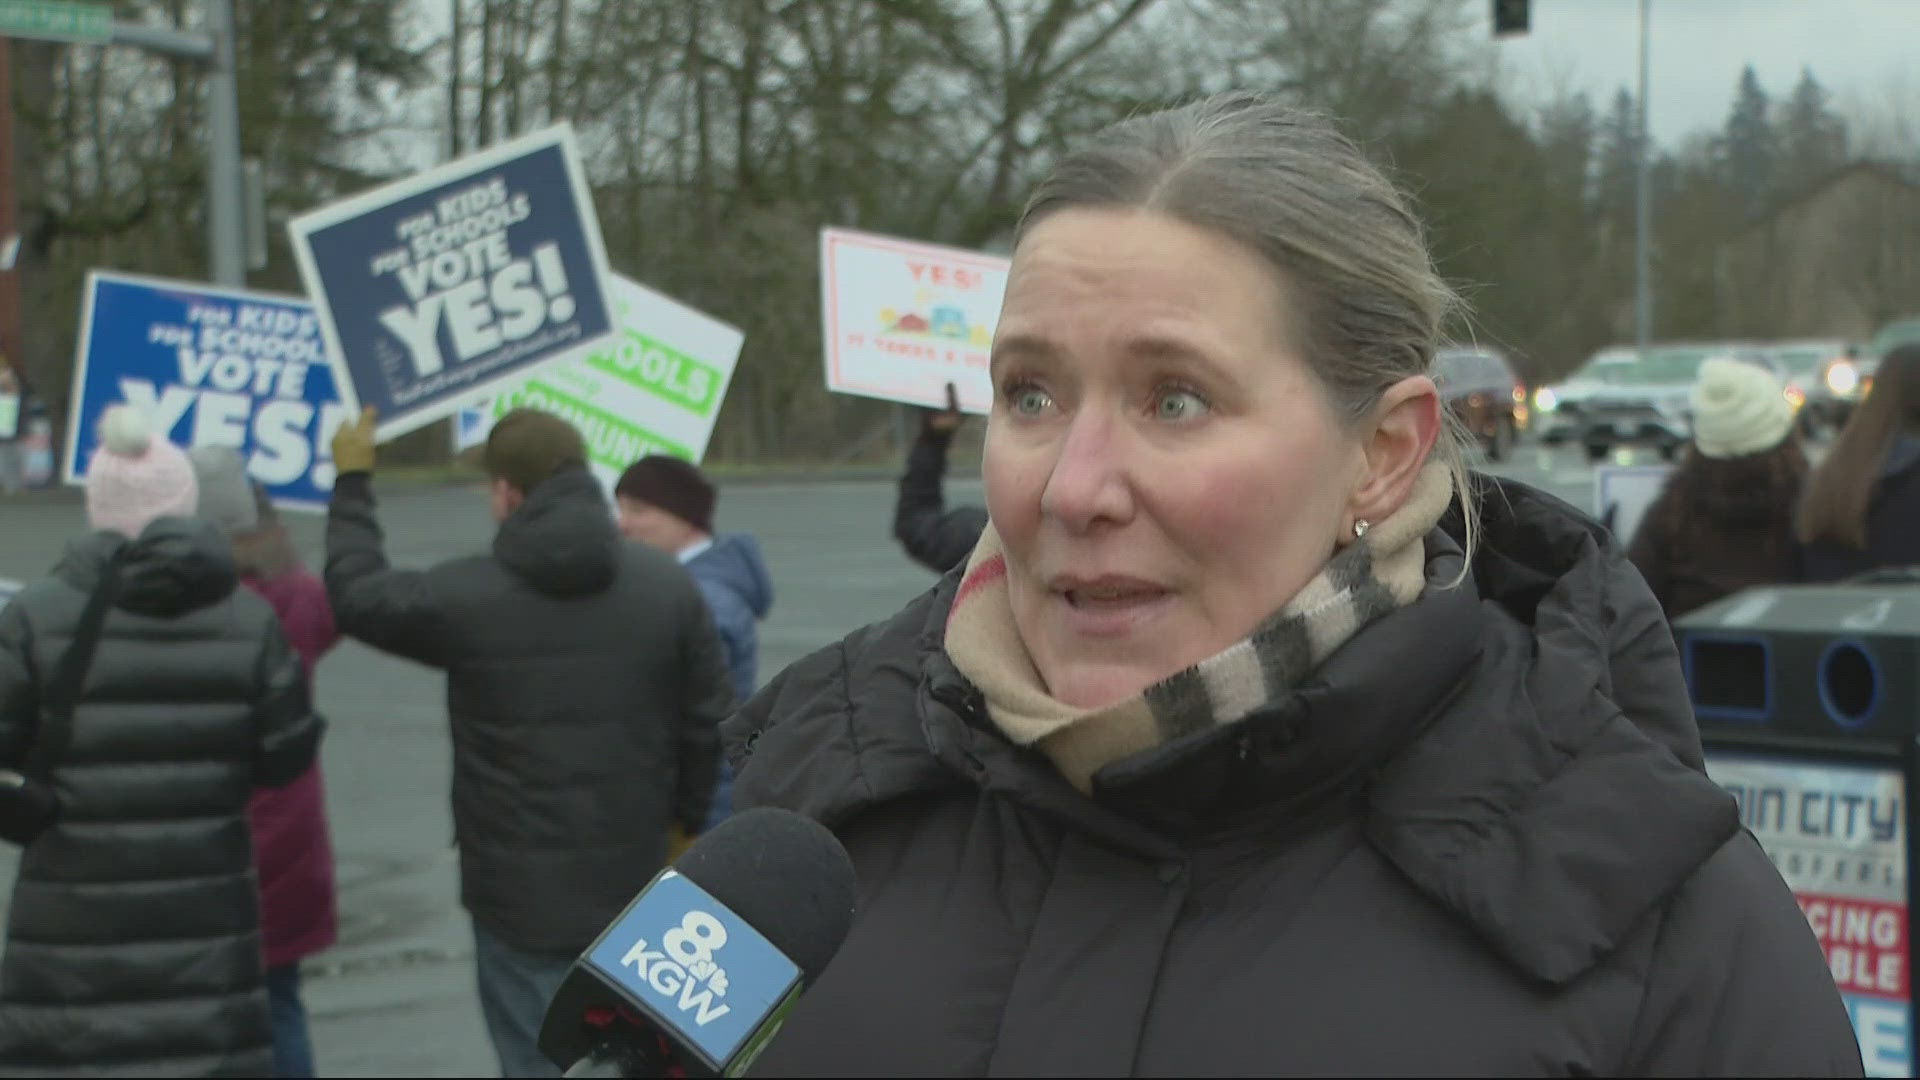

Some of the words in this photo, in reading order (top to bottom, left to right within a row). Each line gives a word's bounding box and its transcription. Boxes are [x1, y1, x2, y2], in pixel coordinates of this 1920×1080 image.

[411, 193, 531, 260] SCHOOLS
[436, 179, 508, 223] KIDS
[397, 229, 512, 302] VOTE
[187, 305, 232, 326] FOR
[237, 304, 319, 339] KIDS
[378, 243, 577, 378] YES!
[176, 348, 311, 399] VOTE
[603, 338, 712, 403] OOLS
[118, 378, 345, 491] YES!
[1799, 790, 1897, 843] CITY
[663, 911, 727, 968] 8
[1800, 902, 1898, 949] CING
[620, 938, 730, 1027] KGW
[1828, 945, 1902, 992] BLE
